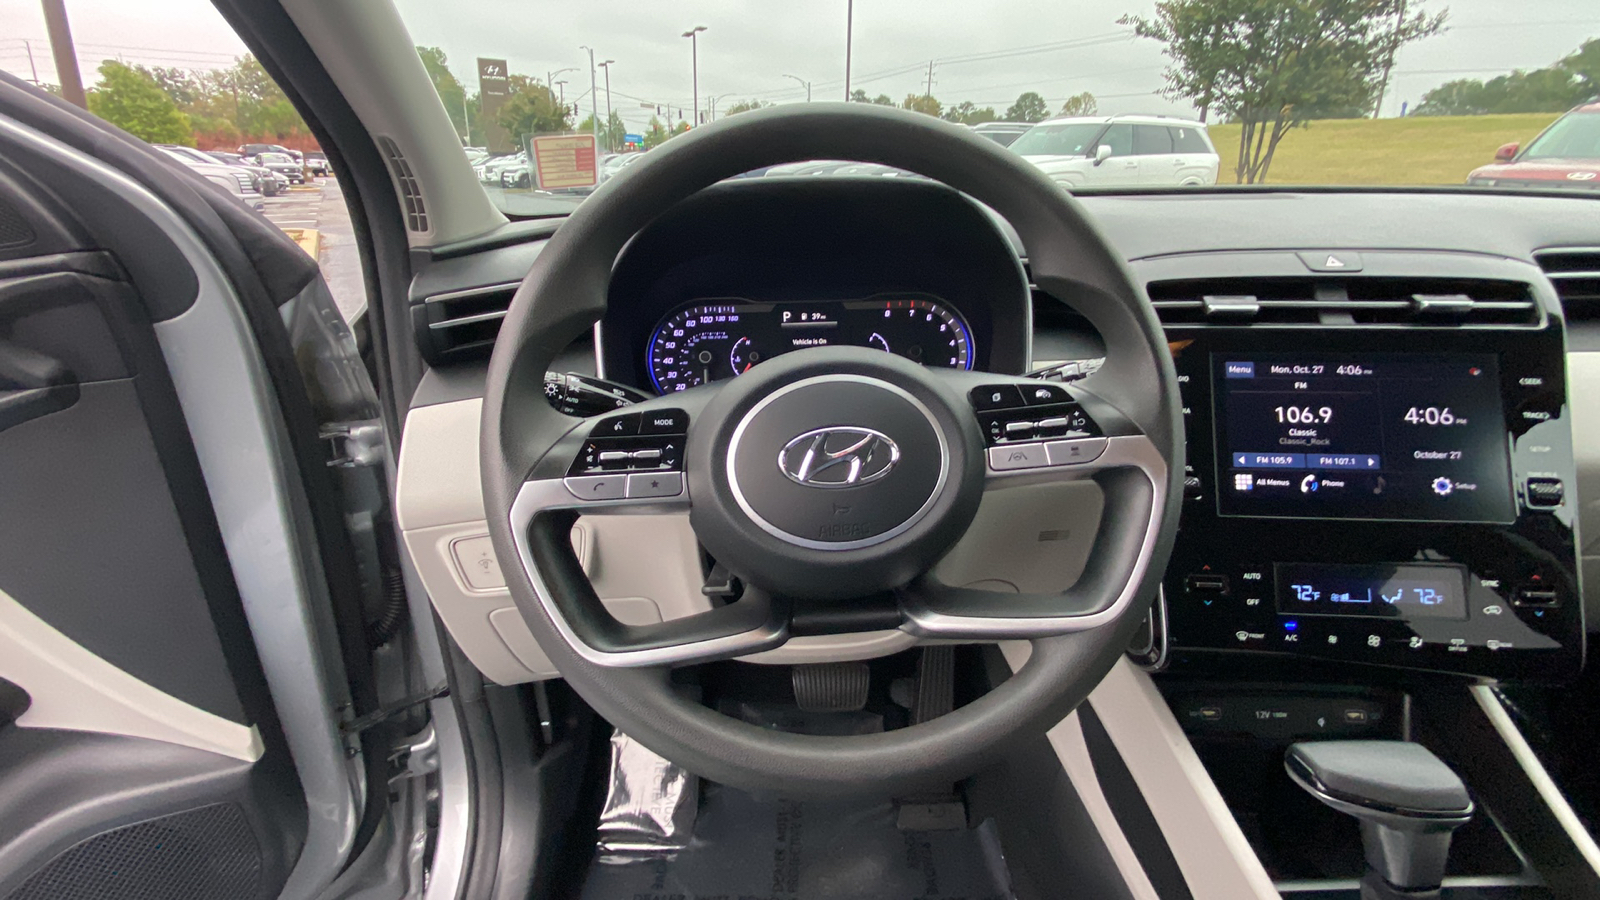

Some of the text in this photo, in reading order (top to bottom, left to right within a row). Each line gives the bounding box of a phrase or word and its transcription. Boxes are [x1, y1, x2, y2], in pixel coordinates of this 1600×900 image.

[783, 311, 791, 322] P
[909, 309, 915, 317] 7
[673, 329, 684, 337] 60
[662, 357, 674, 365] 40
[1228, 365, 1252, 374] Menu
[1270, 365, 1324, 375] Mon, Oct. 27
[1336, 365, 1362, 375] 4:06
[667, 371, 678, 379] 30
[675, 383, 686, 391] 20
[1294, 381, 1308, 389] FM
[565, 396, 579, 404] AUTO
[1274, 406, 1333, 424] 106.9
[1404, 407, 1454, 425] 4:06
[654, 418, 673, 426] MODE
[1288, 428, 1318, 437] Classic
[1413, 450, 1462, 459] October 27
[1256, 456, 1293, 464] FM 105.9
[1319, 457, 1356, 465] FM 107.1
[1256, 478, 1290, 486] All Menus
[1321, 479, 1345, 488] Phone
[819, 523, 872, 538] AIRBAG
[1243, 572, 1262, 580] AUTO
[1481, 579, 1500, 588] SYNC
[1246, 598, 1260, 606] OFF
[1284, 634, 1298, 642] A/C
[1255, 710, 1271, 719] 12V
